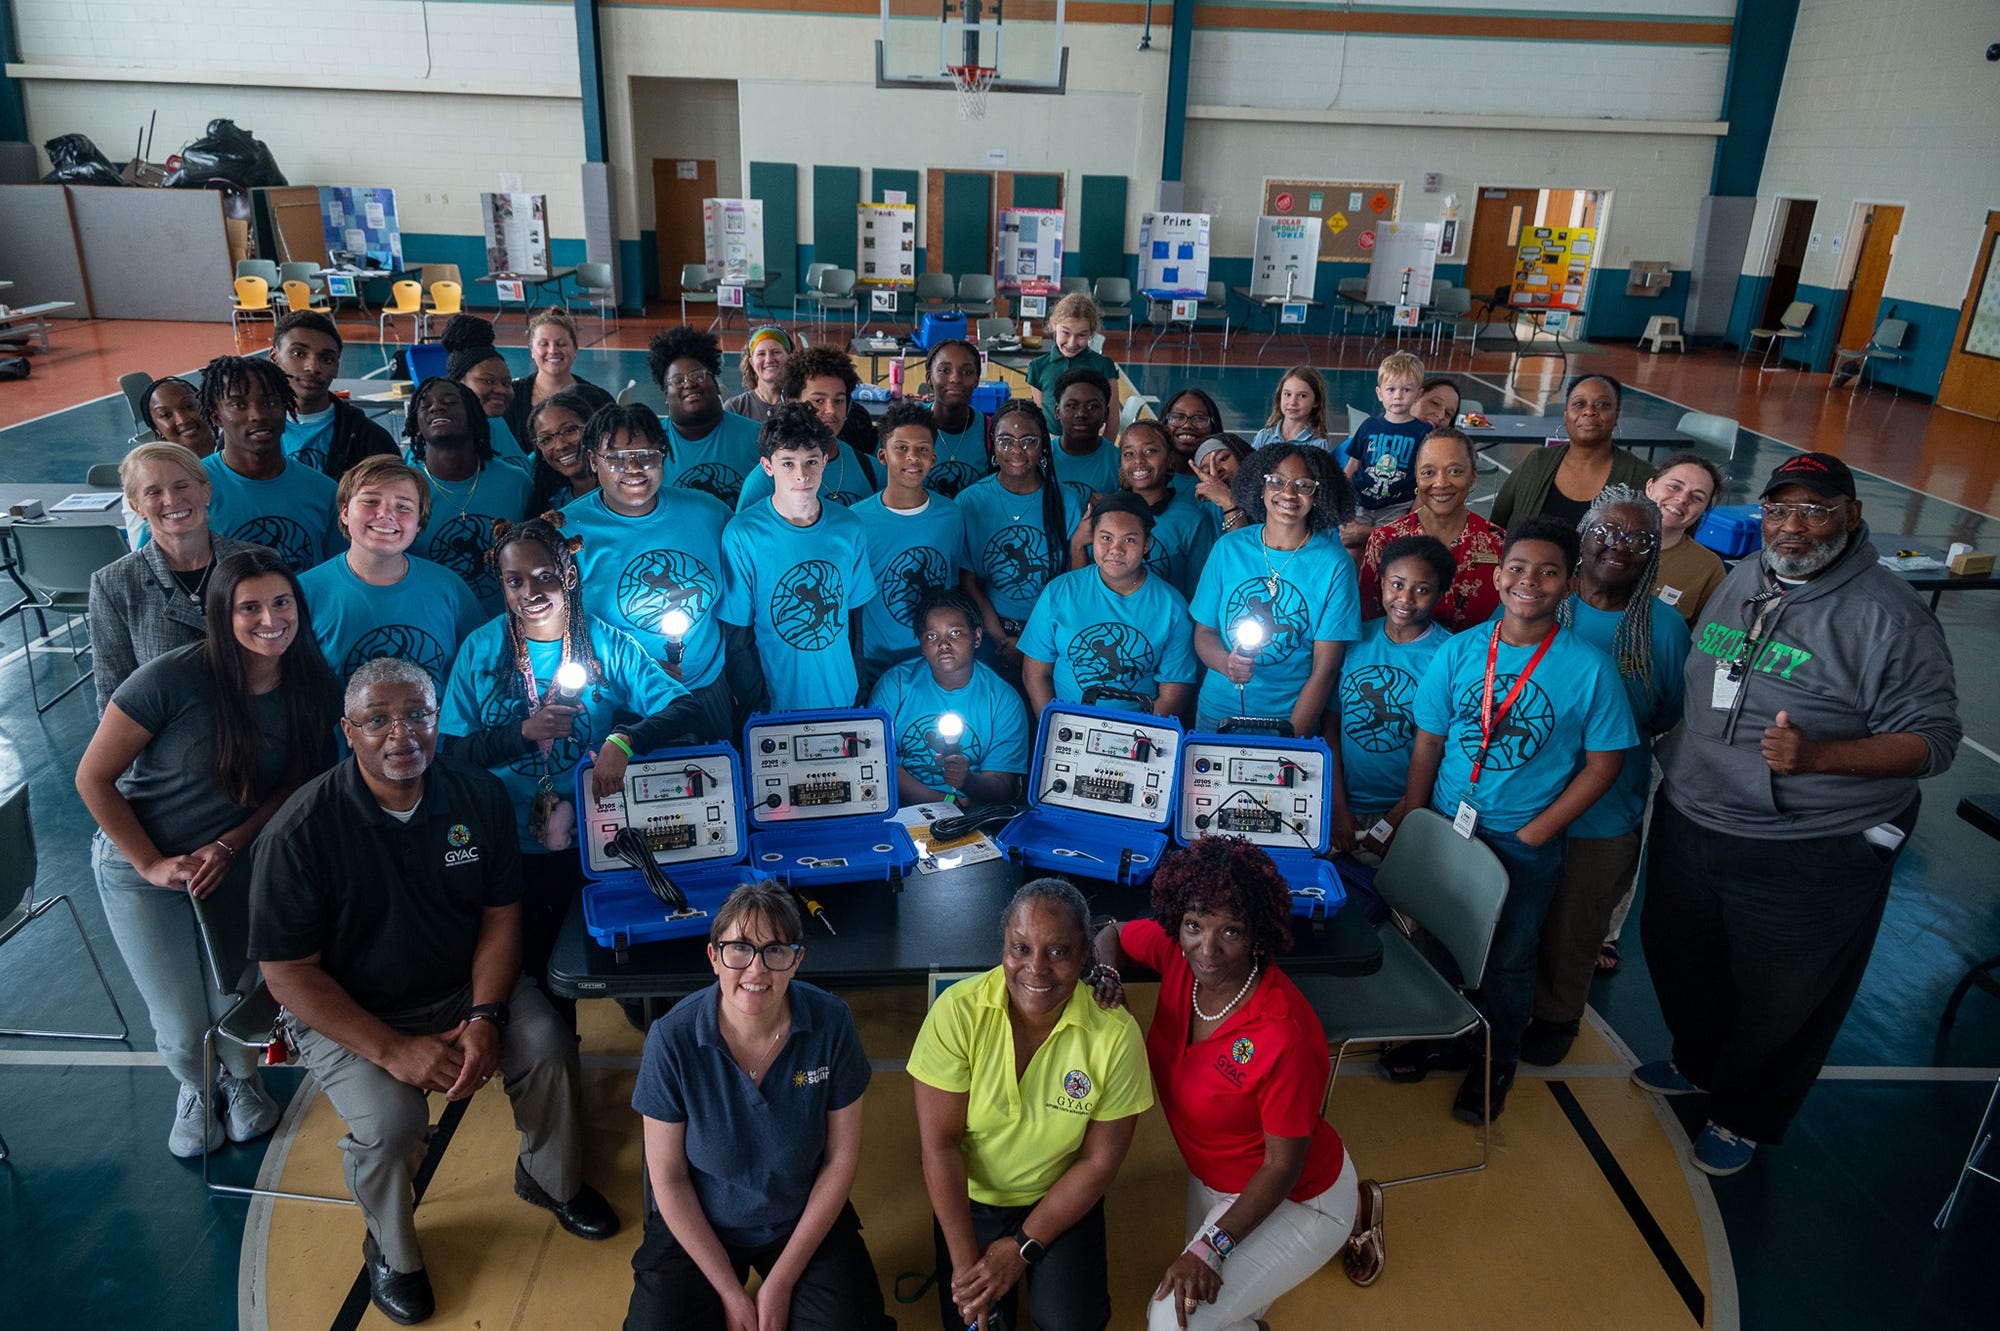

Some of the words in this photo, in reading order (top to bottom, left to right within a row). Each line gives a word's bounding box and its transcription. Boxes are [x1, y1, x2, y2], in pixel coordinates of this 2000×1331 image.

[1163, 215, 1192, 227] Print
[1276, 231, 1304, 239] TOWER
[1697, 622, 1814, 679] SECUITY
[445, 846, 478, 863] GYAC
[1217, 1054, 1247, 1085] GYAC
[1057, 1096, 1093, 1111] GYAC
